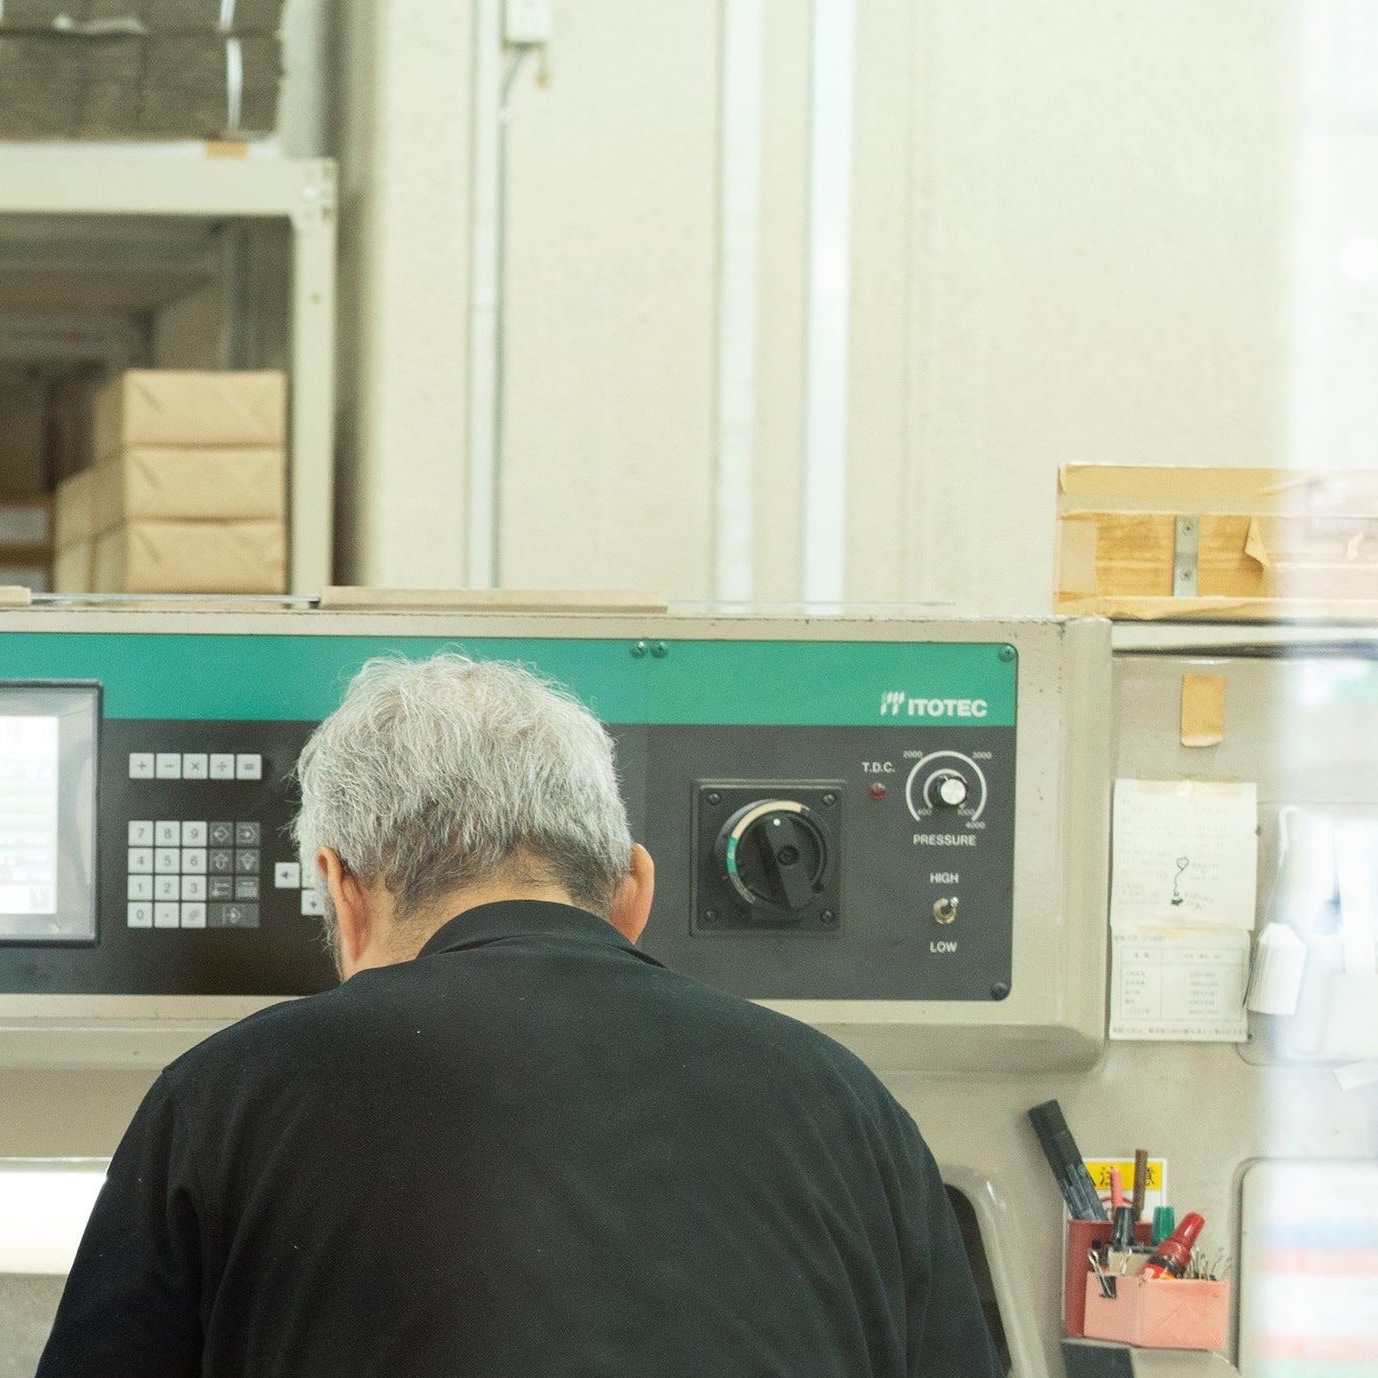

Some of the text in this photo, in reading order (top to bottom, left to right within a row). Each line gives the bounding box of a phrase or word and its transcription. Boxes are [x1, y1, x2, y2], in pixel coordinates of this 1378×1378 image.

[908, 698, 988, 717] ITOTEC
[903, 750, 924, 759] 2000
[971, 751, 993, 760] 3000
[862, 762, 896, 773] T.D.C.
[965, 821, 986, 830] 4000
[913, 834, 976, 847] PRESSURE
[930, 873, 959, 884] HIGH
[930, 942, 957, 953] LOW
